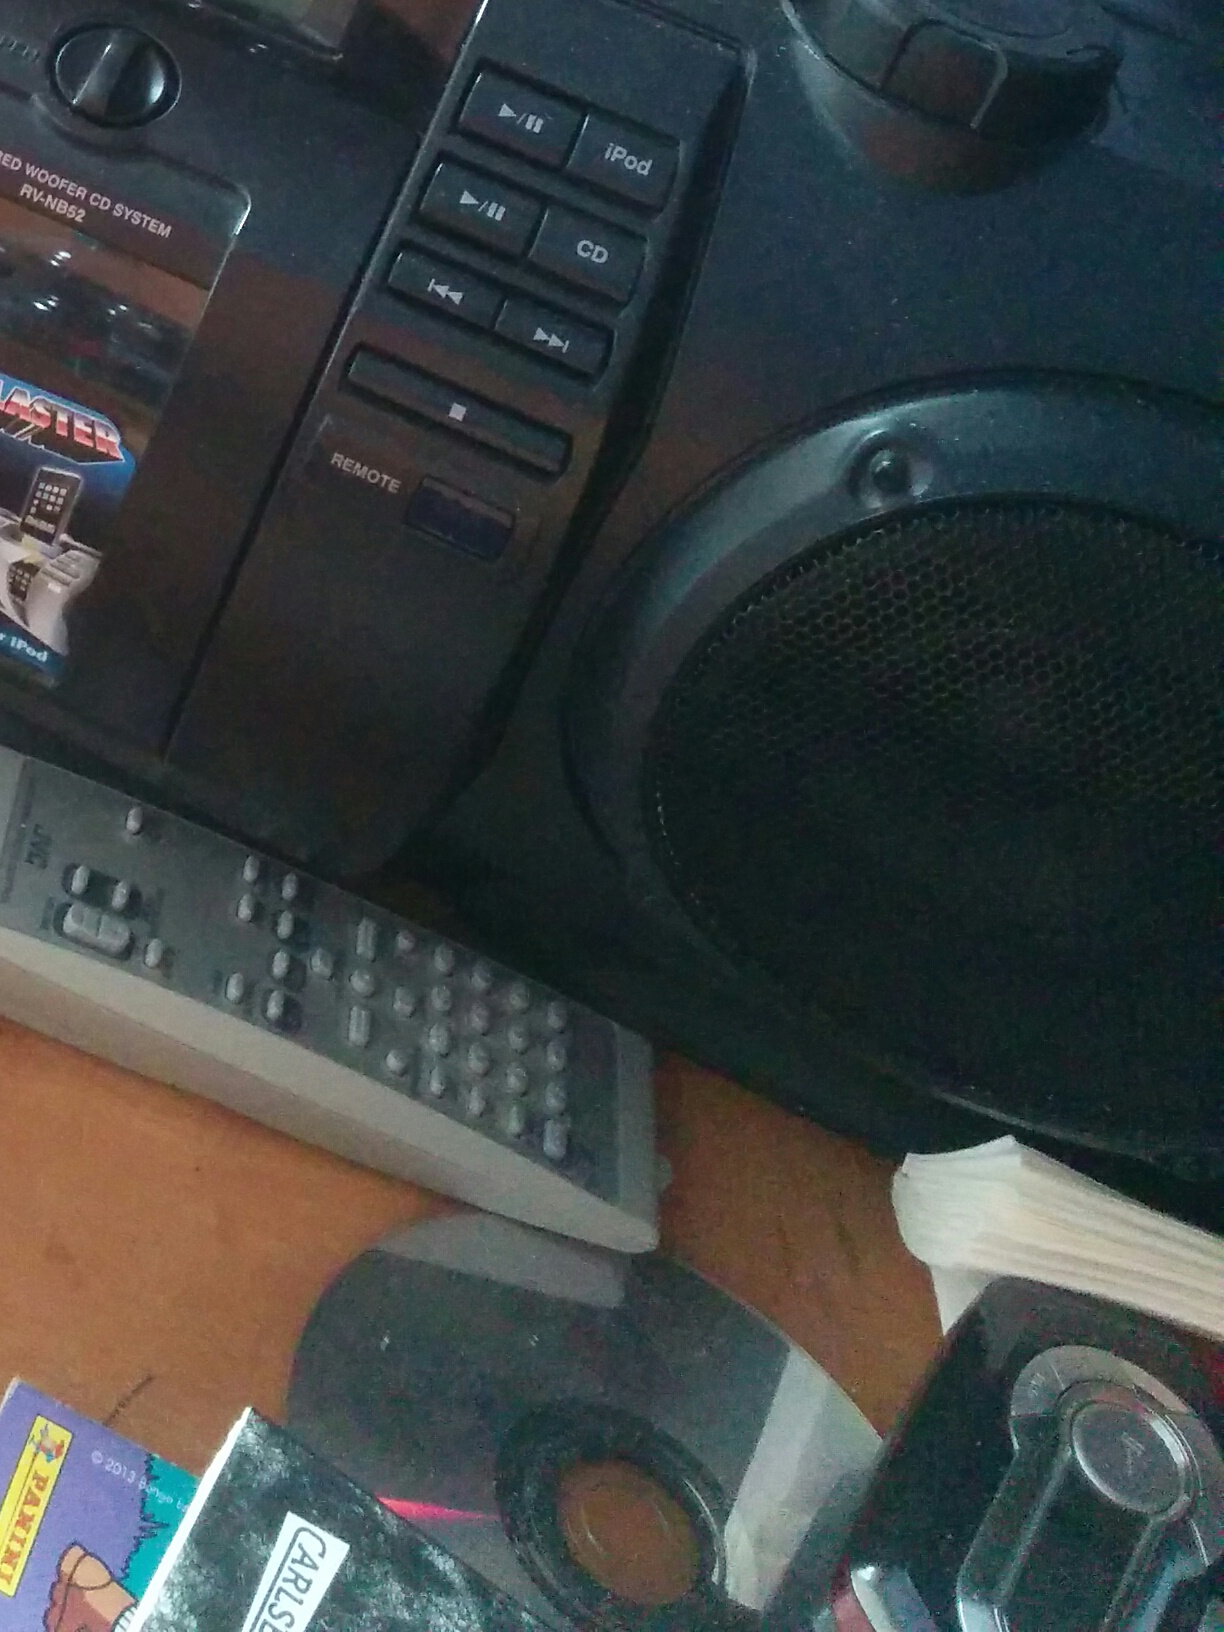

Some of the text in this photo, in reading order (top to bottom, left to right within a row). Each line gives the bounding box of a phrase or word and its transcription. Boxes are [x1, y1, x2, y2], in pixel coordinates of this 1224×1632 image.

[604, 142, 653, 176] iPod
[19, 183, 88, 223] RV-NB52
[25, 163, 88, 201] WOOFER
[89, 193, 112, 211] CD
[113, 203, 172, 239] SYSTEM
[576, 239, 609, 264] CD
[330, 452, 402, 494] REMOTE
[10, 636, 48, 662] iPod
[104, 1457, 136, 1483] 2013
